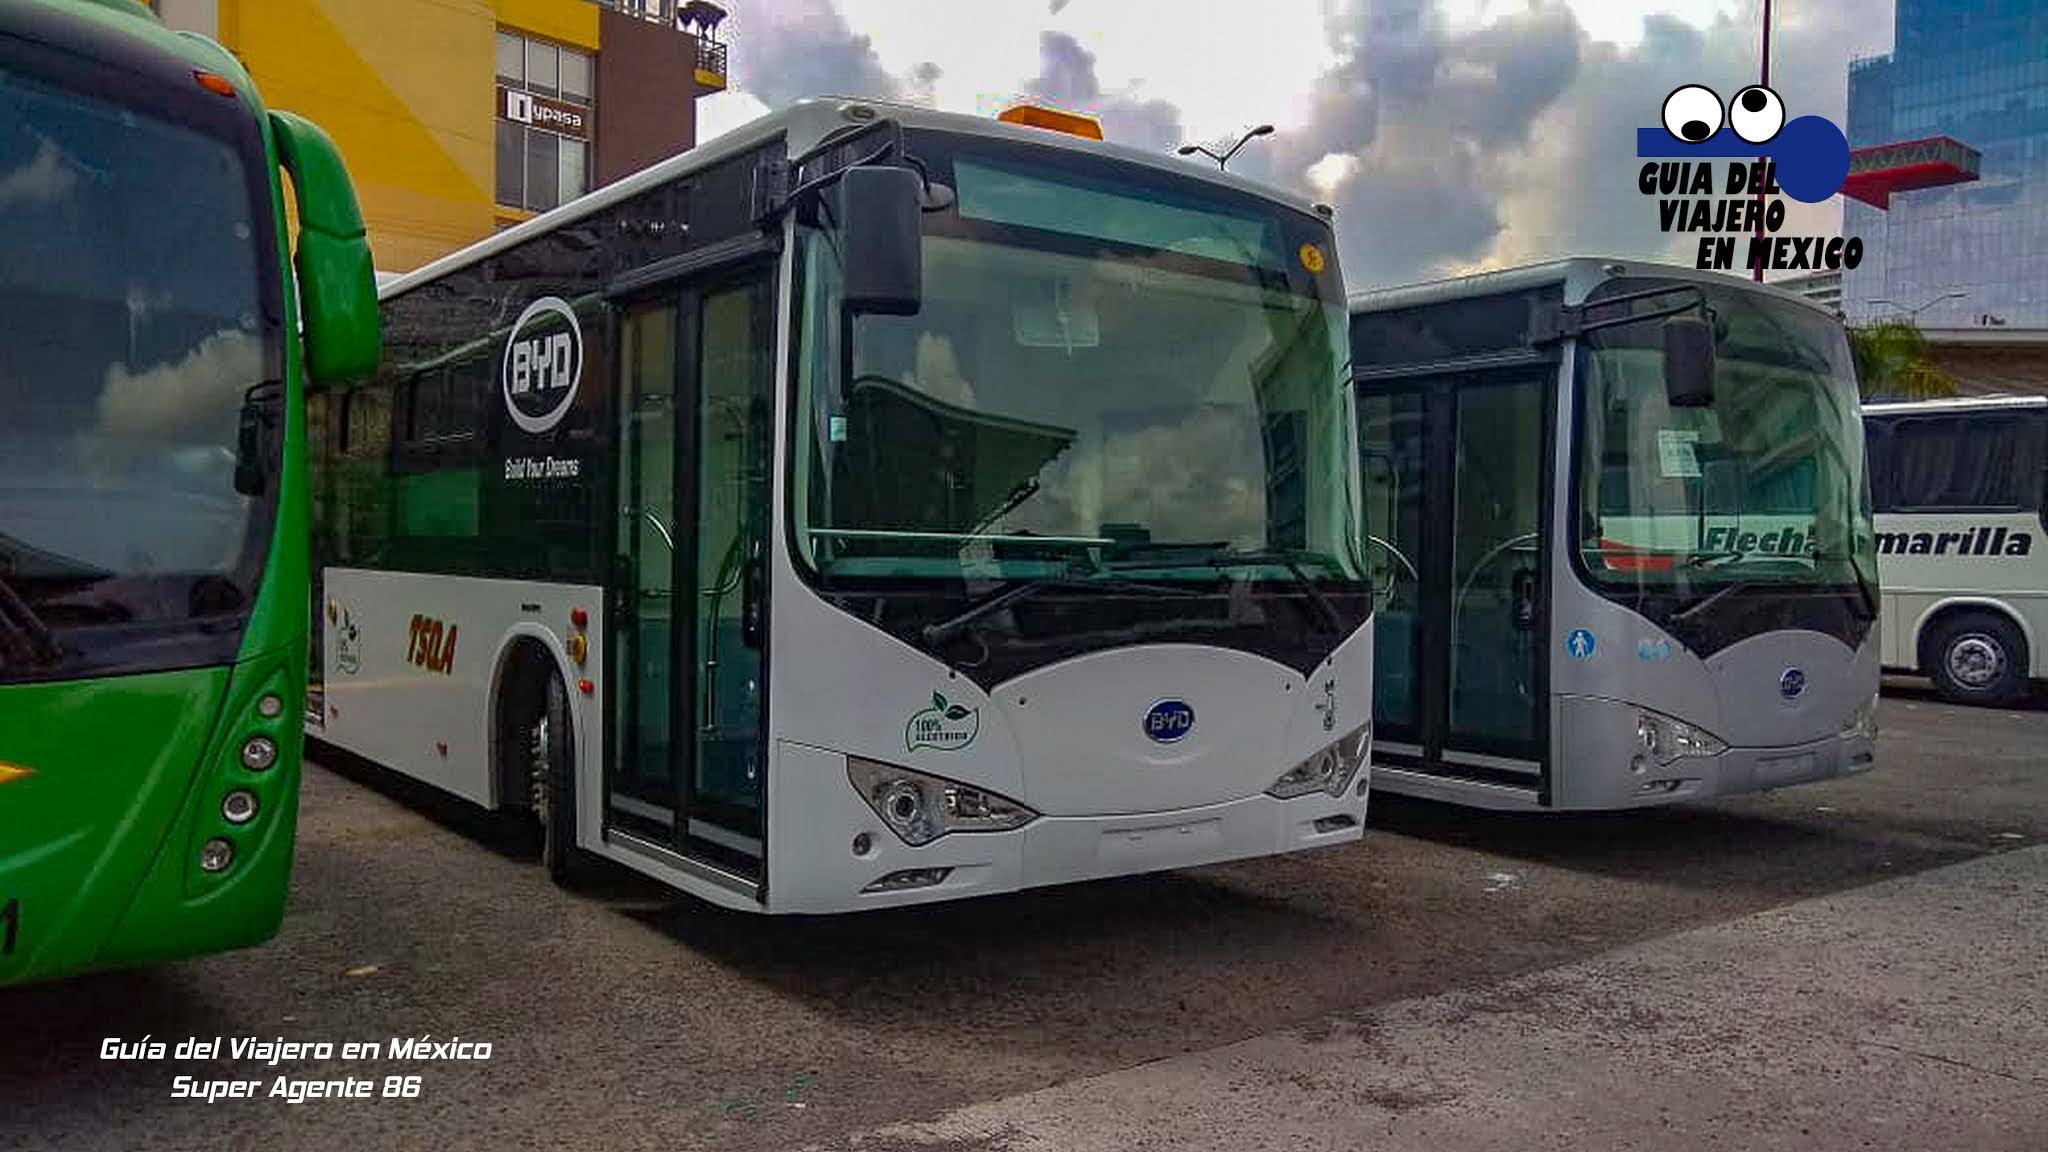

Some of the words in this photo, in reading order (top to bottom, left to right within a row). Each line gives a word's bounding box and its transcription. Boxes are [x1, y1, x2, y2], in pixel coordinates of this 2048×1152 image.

[512, 332, 572, 394] BYD
[1857, 527, 2032, 556] marilla
[1151, 710, 1190, 730] BYD
